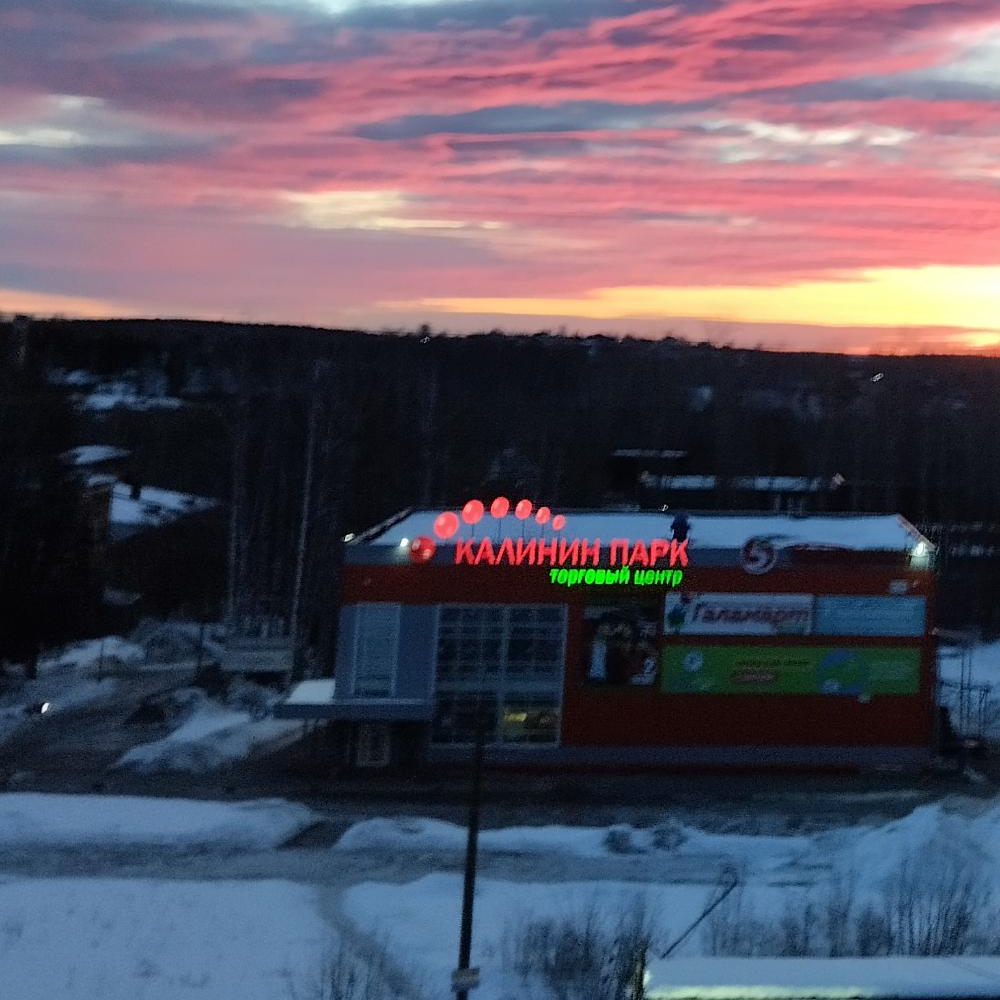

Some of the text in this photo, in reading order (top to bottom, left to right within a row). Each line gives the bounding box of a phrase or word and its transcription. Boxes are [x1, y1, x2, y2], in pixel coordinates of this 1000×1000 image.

[455, 536, 689, 567] КАЛИНИН ПАРК
[550, 566, 683, 587] торговый центр
